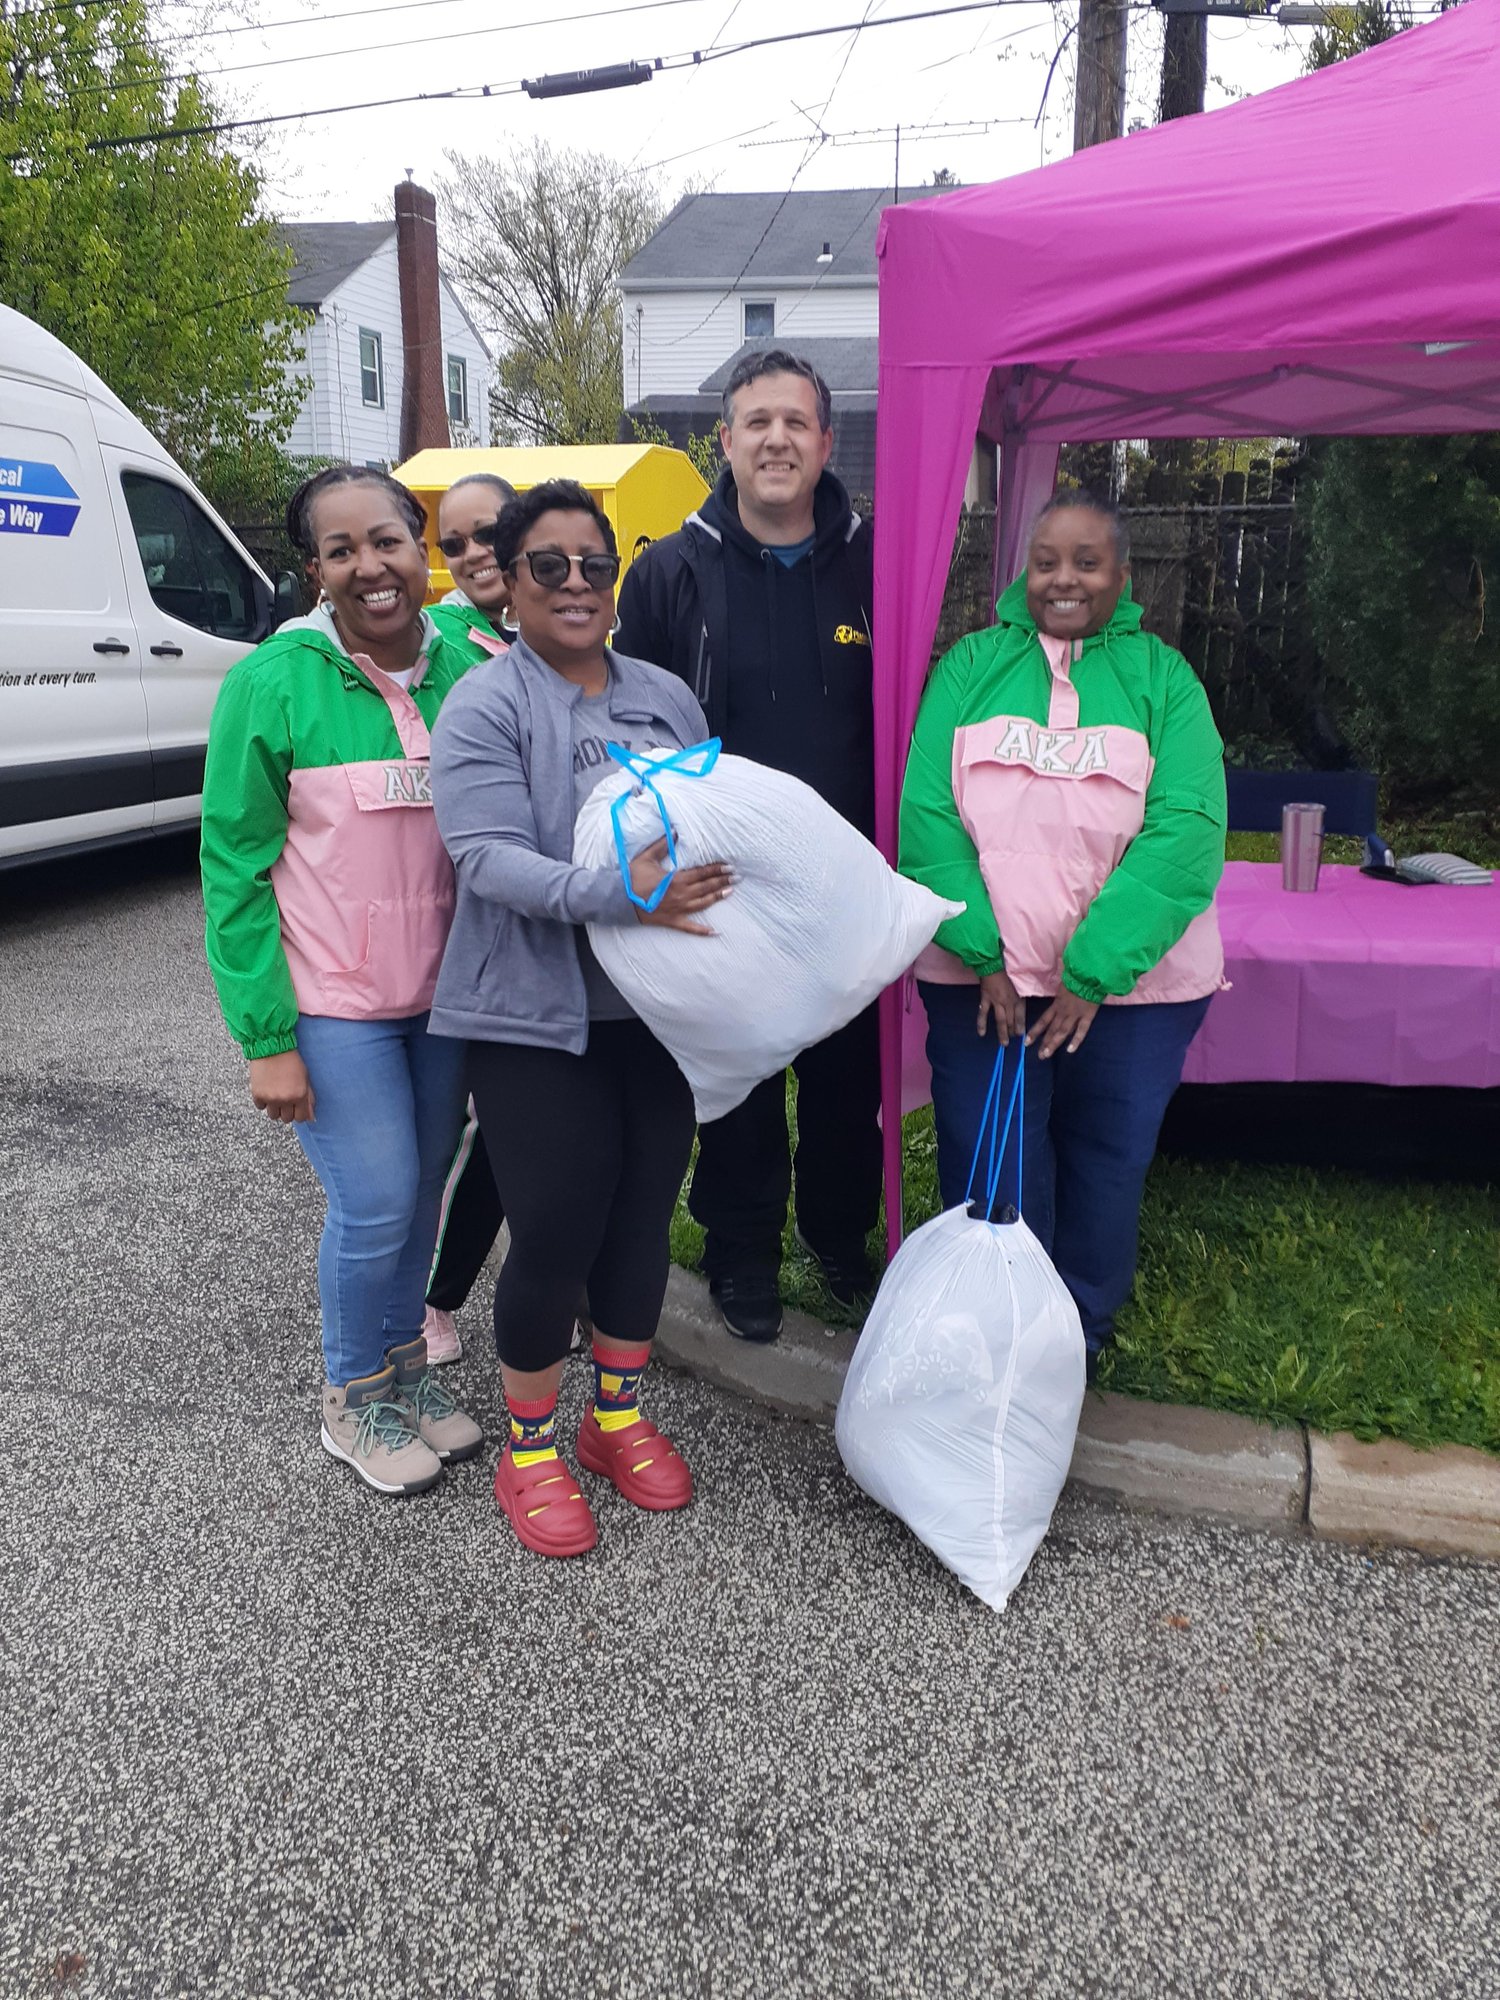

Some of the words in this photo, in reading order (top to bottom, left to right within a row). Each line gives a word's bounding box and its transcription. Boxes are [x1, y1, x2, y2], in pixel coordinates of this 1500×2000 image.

[10, 503, 43, 533] Way
[23, 672, 37, 686] at
[39, 672, 71, 688] every
[72, 671, 96, 684] turn.
[994, 720, 1108, 774] AKA
